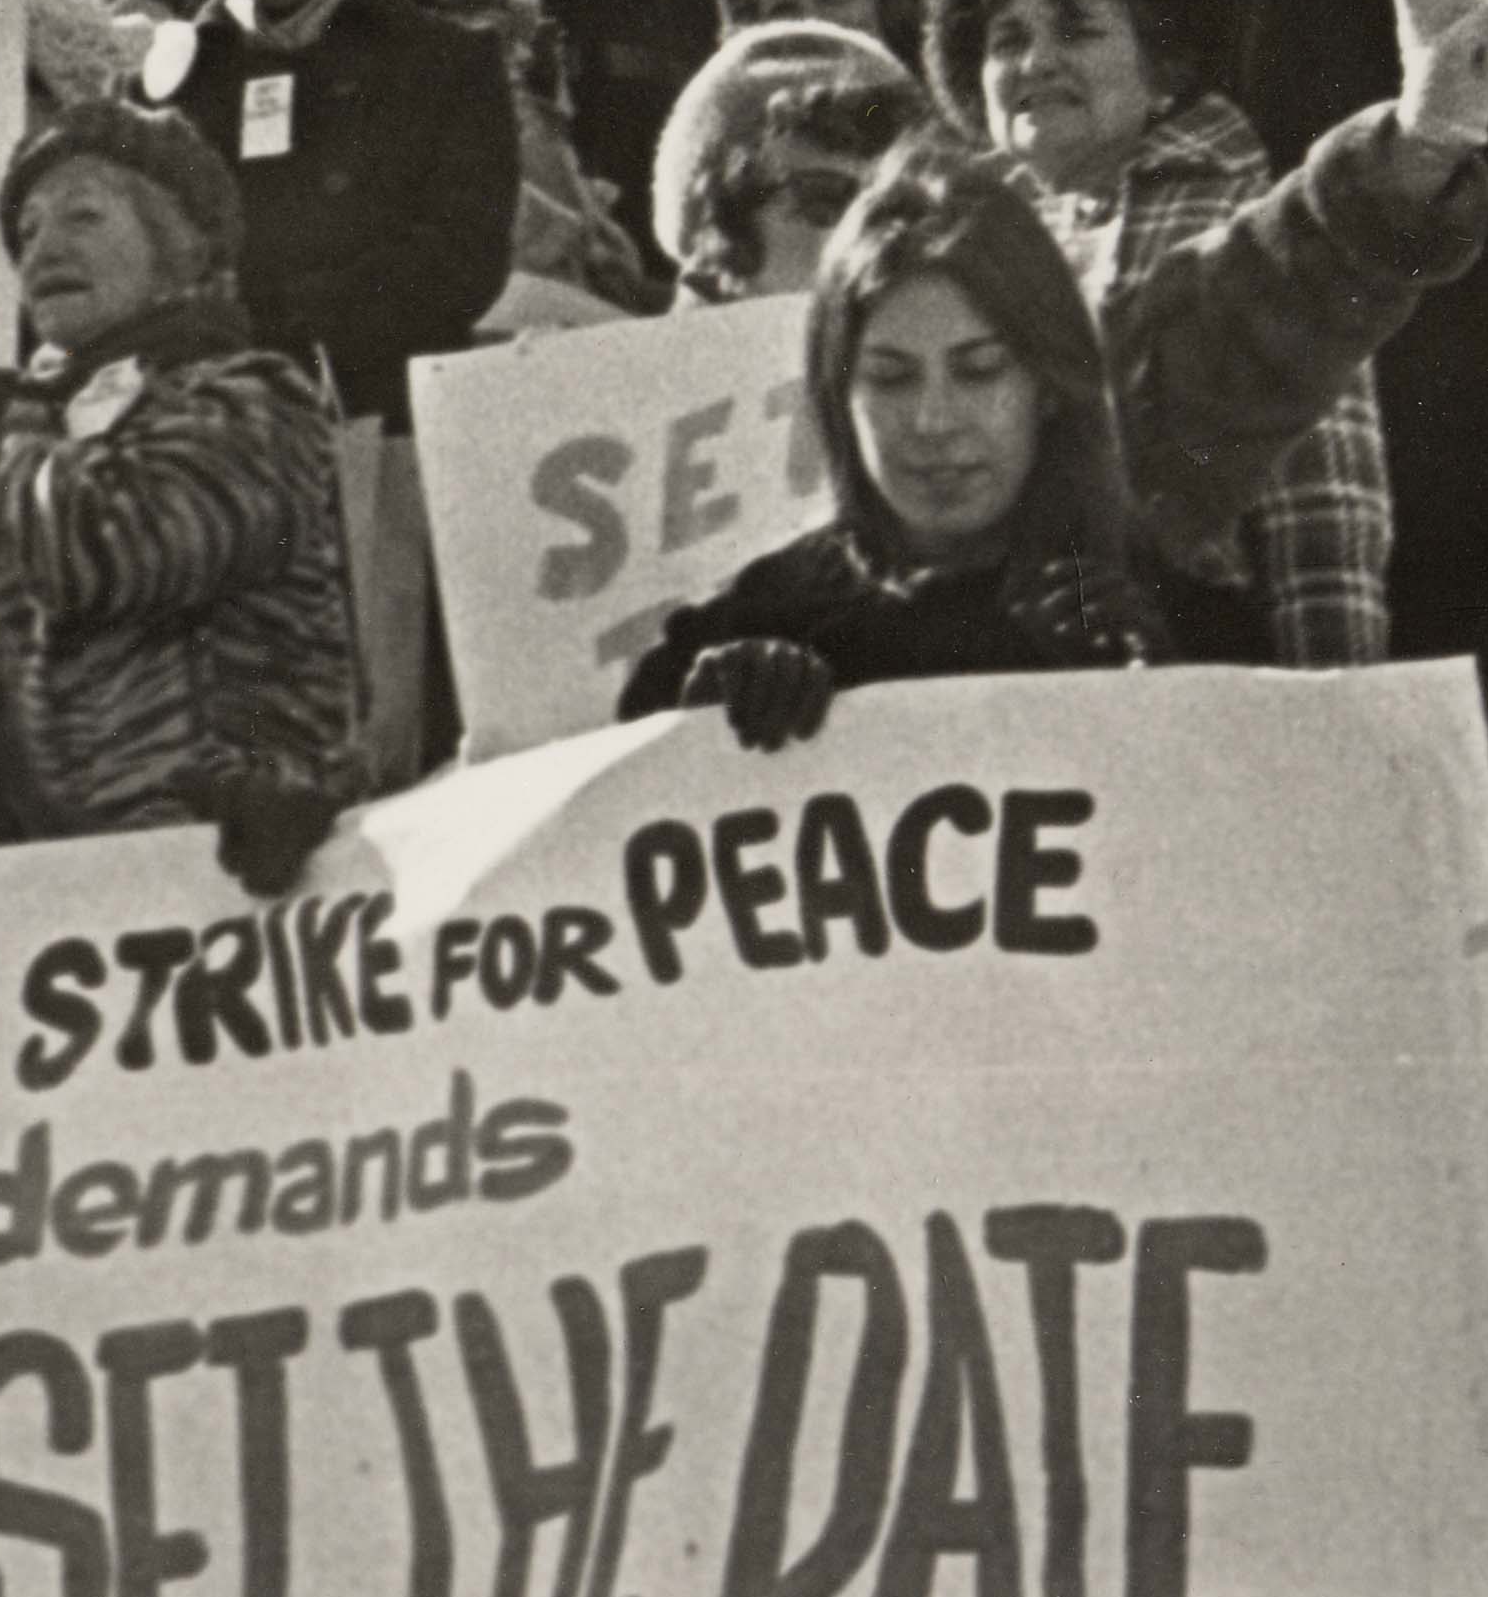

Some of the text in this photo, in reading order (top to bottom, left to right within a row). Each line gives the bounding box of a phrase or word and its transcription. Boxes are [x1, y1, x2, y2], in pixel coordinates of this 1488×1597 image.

[17, 893, 413, 1091] STRIKE
[431, 907, 620, 1021] FOR
[626, 785, 1099, 984] PEACE
